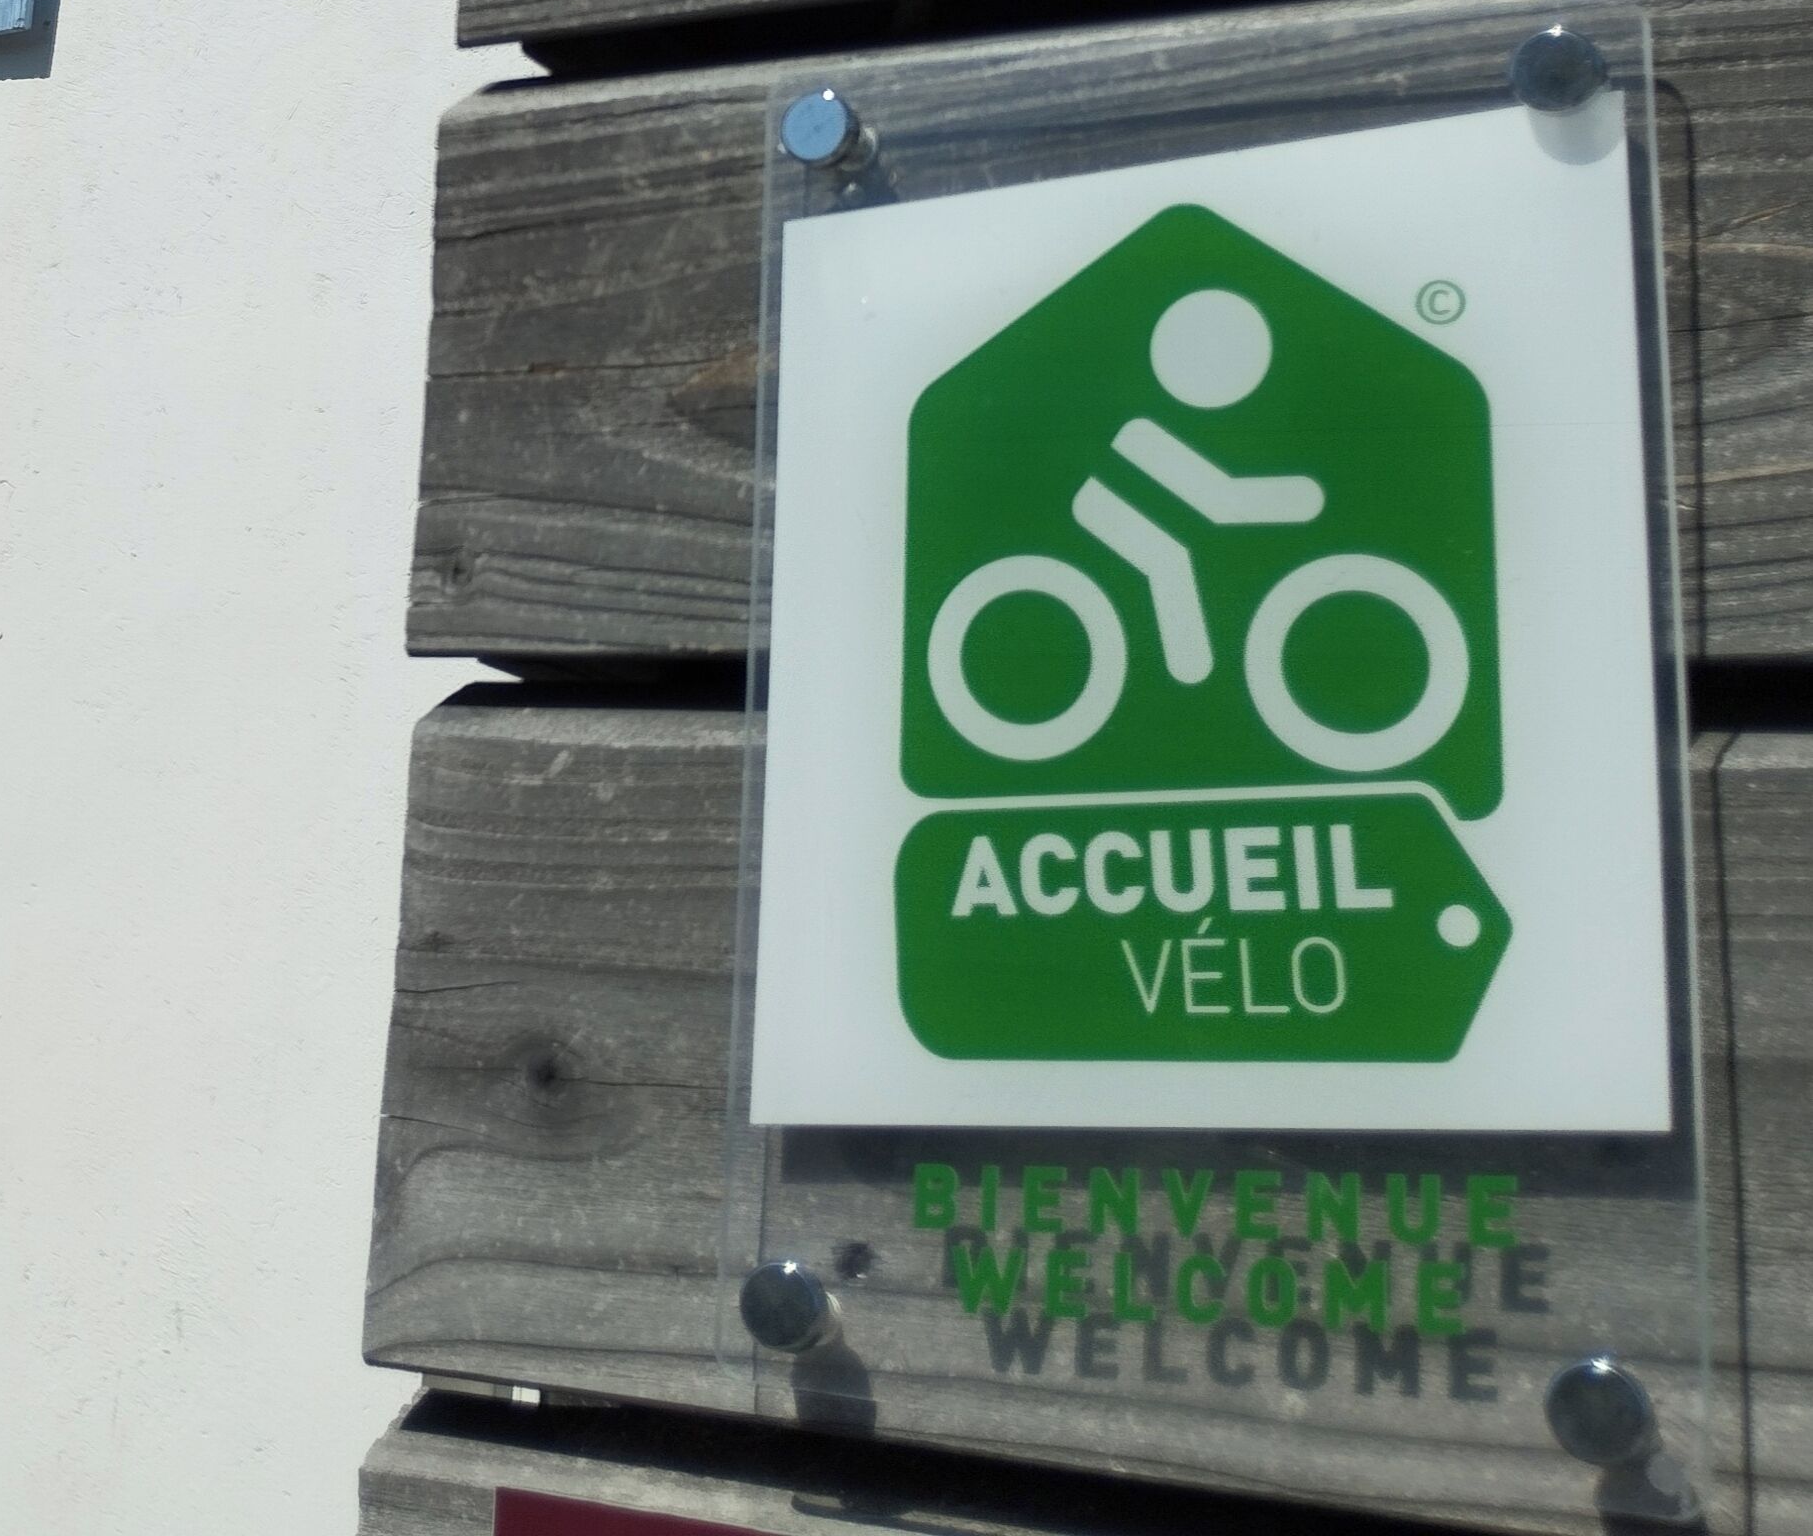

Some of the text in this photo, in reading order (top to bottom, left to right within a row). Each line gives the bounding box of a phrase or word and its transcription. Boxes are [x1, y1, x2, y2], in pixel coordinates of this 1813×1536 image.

[950, 824, 1394, 917] ACCUEIL
[1121, 917, 1347, 1014] VÉLO
[912, 1163, 1518, 1247] BIENVENUE
[951, 1244, 1465, 1335] WELCOME
